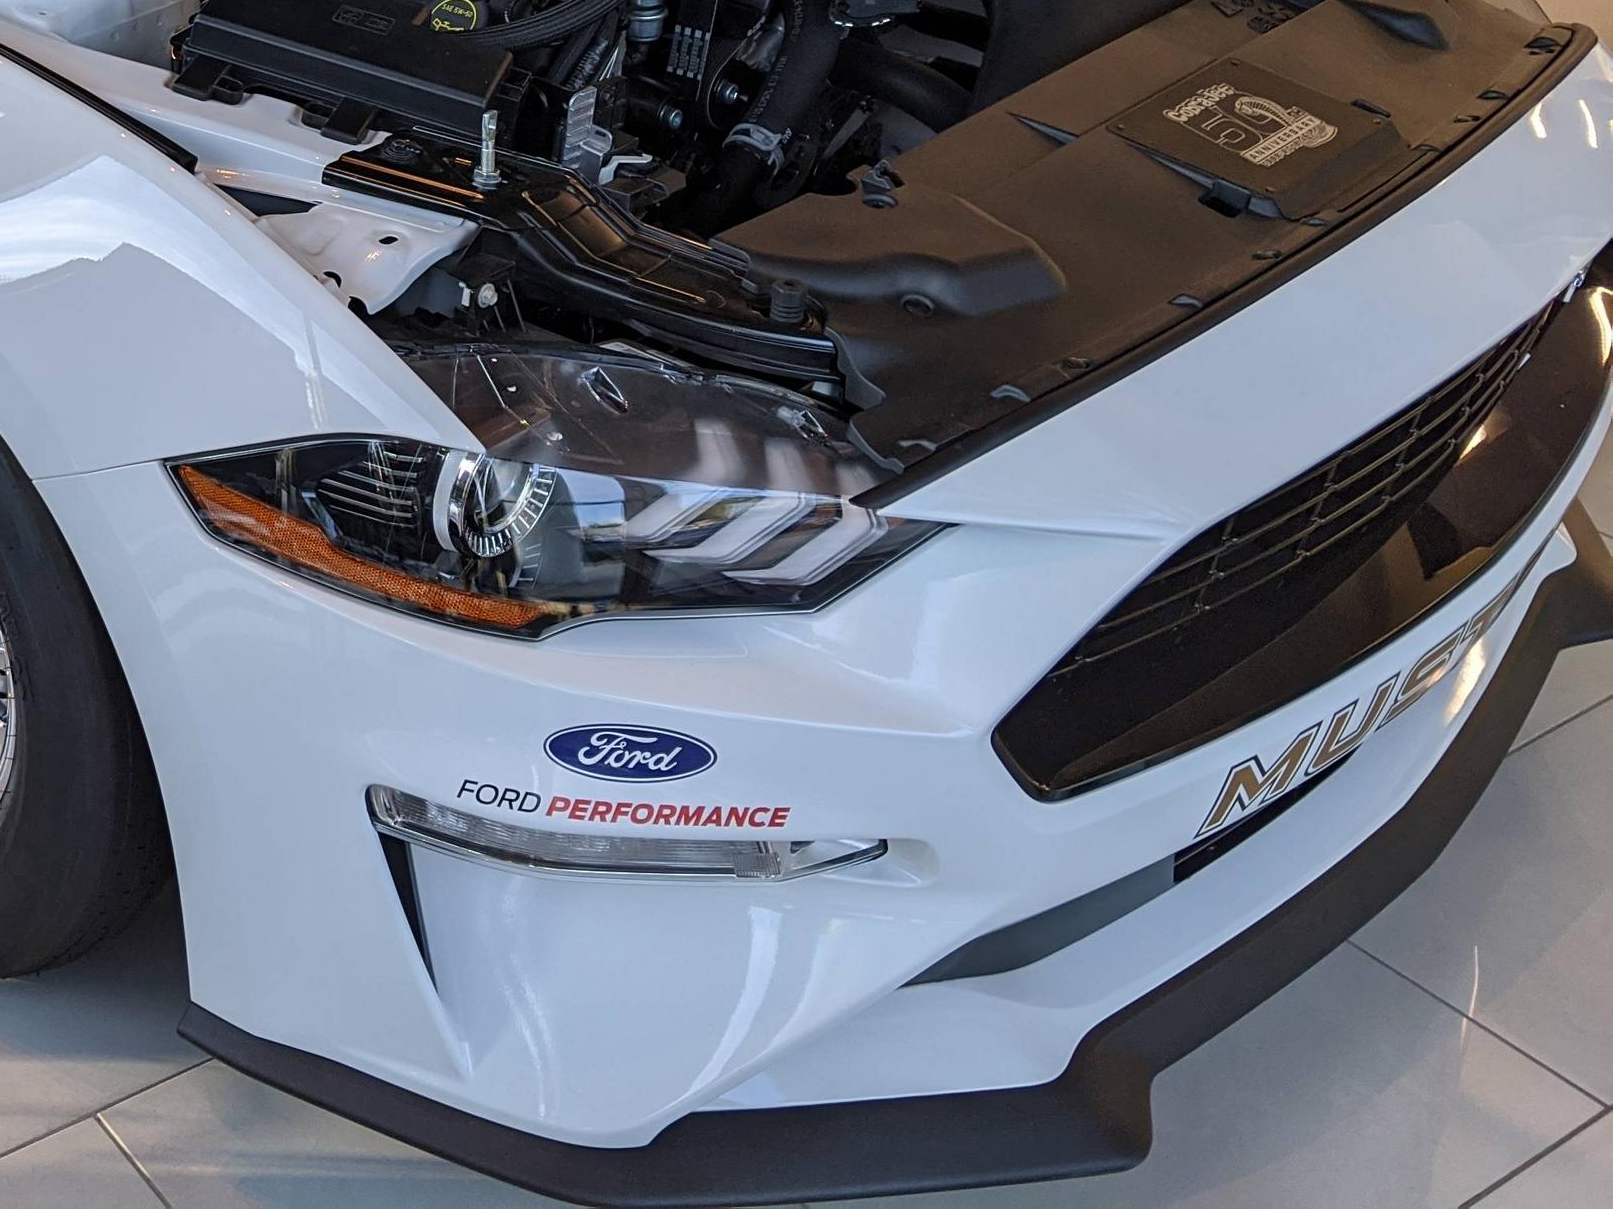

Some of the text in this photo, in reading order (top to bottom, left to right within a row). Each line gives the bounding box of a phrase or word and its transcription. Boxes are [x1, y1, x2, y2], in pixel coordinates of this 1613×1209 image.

[1247, 116, 1319, 162] ANNIVERSARY
[577, 730, 683, 772] Ford
[456, 778, 791, 828] FORD PERFORMANCE
